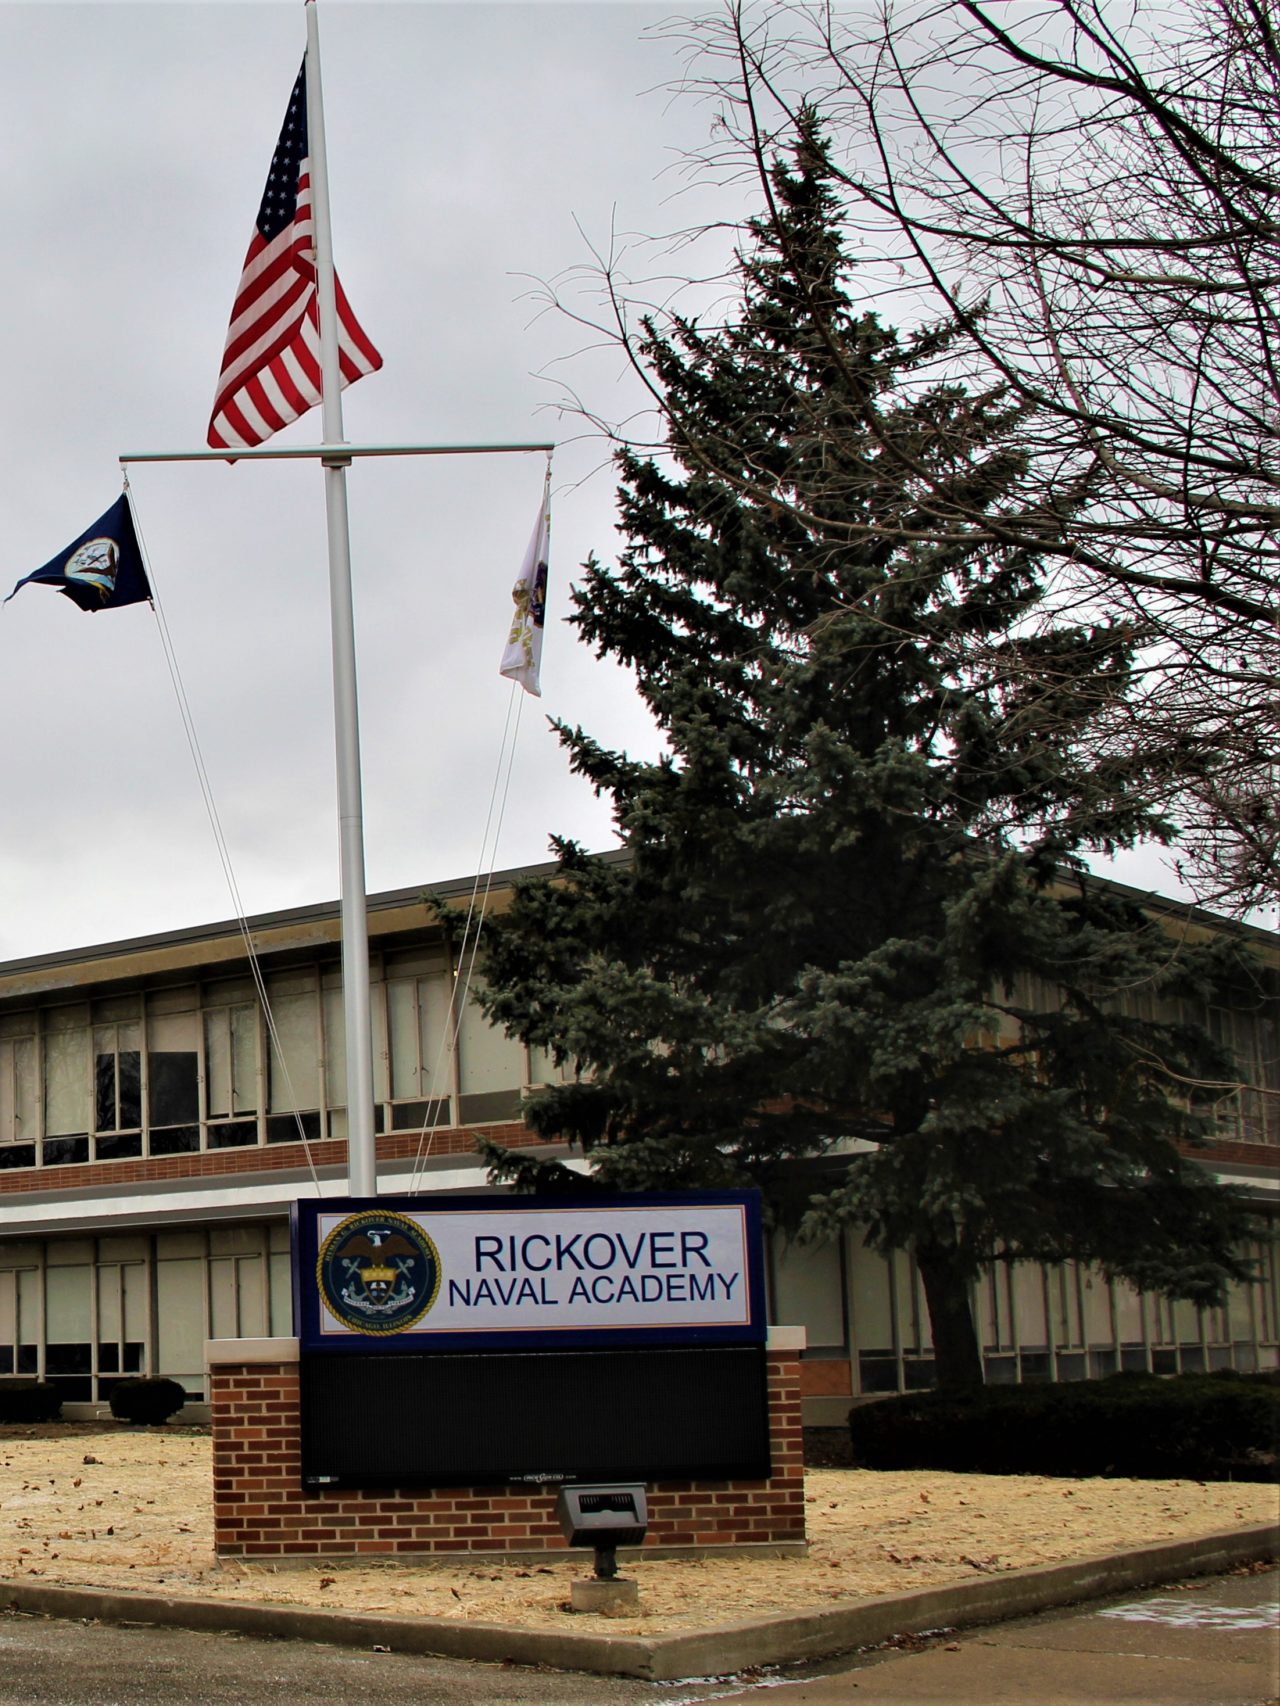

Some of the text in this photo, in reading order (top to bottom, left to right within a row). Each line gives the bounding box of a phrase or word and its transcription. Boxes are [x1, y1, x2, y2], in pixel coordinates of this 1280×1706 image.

[474, 1231, 712, 1273] RICKOVER
[448, 1277, 558, 1307] NAVAL
[568, 1272, 739, 1305] ACADEMY
